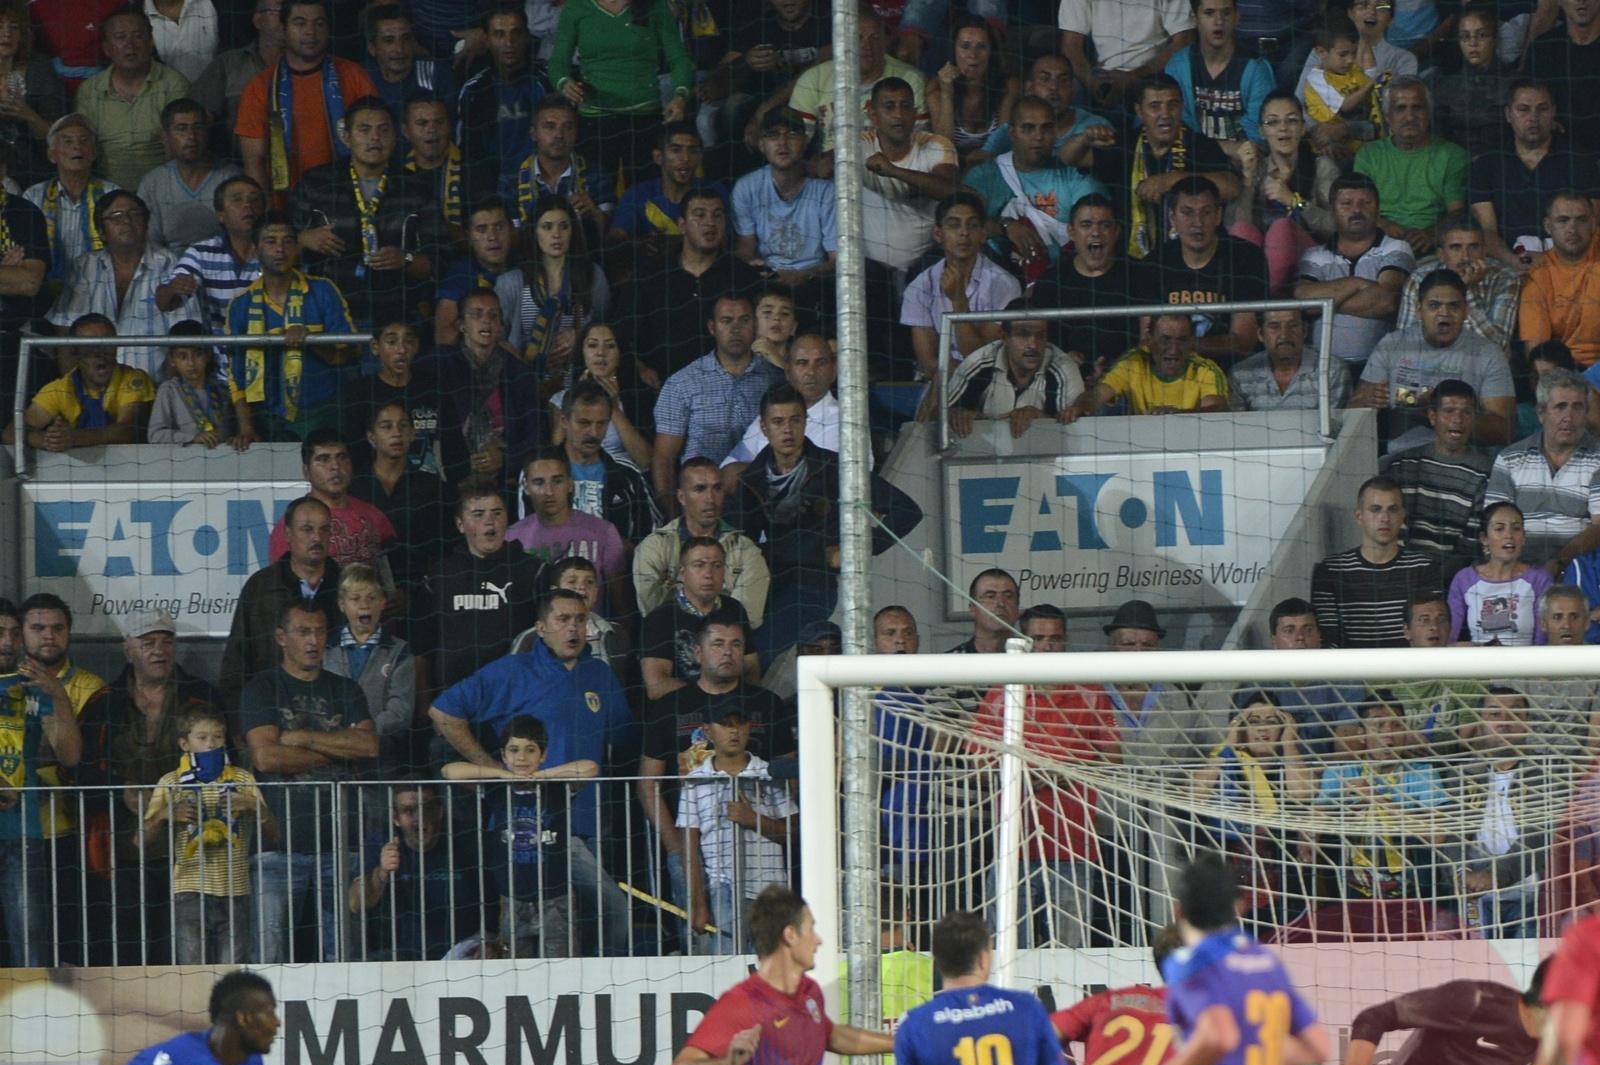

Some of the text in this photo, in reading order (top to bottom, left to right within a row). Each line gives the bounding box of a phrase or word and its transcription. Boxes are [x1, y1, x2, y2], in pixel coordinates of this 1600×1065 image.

[35, 500, 290, 577] EATON
[959, 470, 1224, 554] EATON
[1019, 567, 1109, 594] Powering
[1116, 564, 1203, 588] Business
[933, 998, 1015, 1025] algabeth
